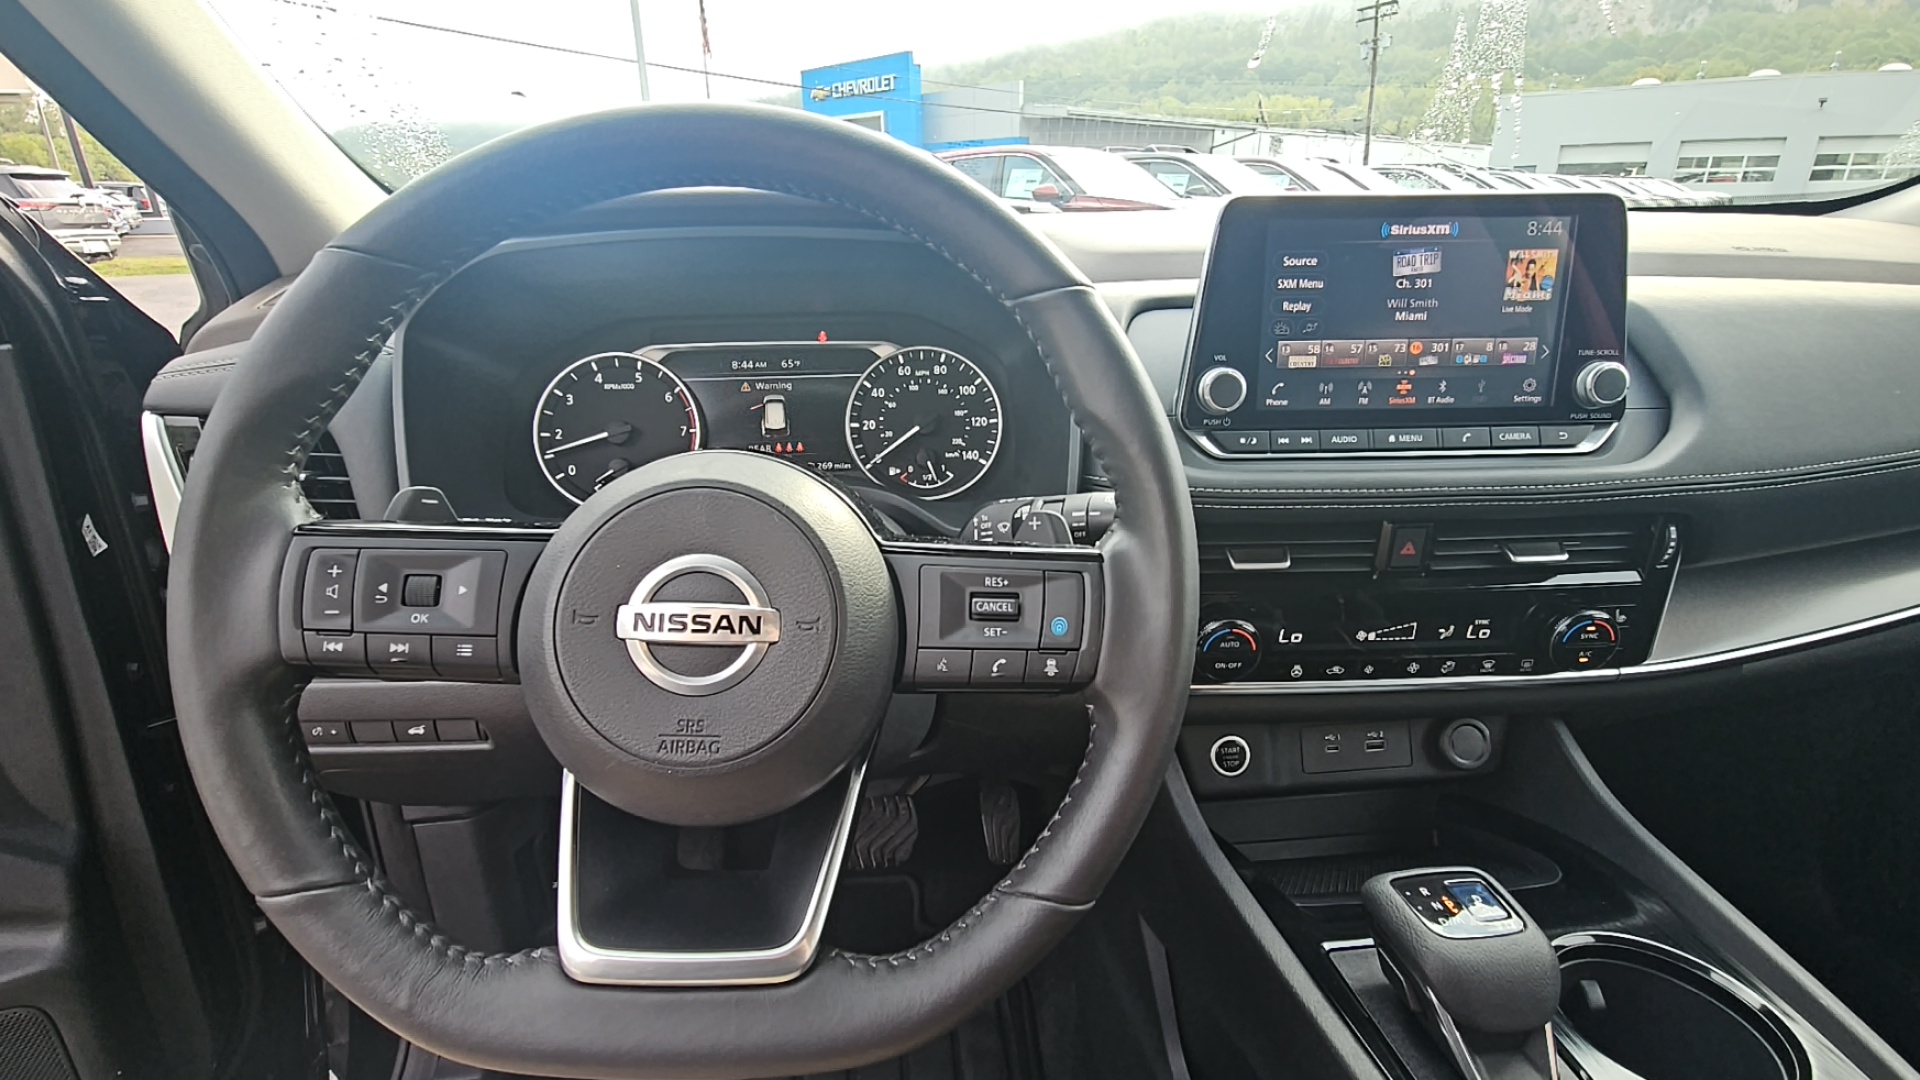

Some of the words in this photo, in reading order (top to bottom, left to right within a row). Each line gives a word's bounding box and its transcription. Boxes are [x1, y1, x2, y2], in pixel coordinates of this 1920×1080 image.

[832, 74, 896, 98] CHEVROLET
[1526, 221, 1563, 236] 8:44
[1283, 256, 1318, 266] Source
[1419, 252, 1439, 266] TRIP
[1277, 279, 1297, 289] SXM
[1299, 279, 1324, 289] Menu
[1396, 278, 1412, 288] Ch.
[1414, 278, 1433, 288] 301
[1282, 301, 1312, 313] Replay
[1387, 298, 1408, 308] Will
[1410, 298, 1438, 308] Smith
[1515, 305, 1533, 313] Mode
[1394, 311, 1427, 321] Miami
[1281, 346, 1290, 354] 13
[1308, 345, 1320, 354] 58
[1325, 345, 1334, 354] 14
[1351, 344, 1363, 354] 57
[1368, 345, 1377, 353] 15
[1394, 344, 1406, 353] 73
[1431, 343, 1449, 352] 301
[1455, 343, 1464, 351] 17
[1486, 342, 1493, 352] 8
[1498, 343, 1507, 351] 18
[1523, 342, 1536, 352] 28
[732, 361, 753, 369] 8:44
[934, 365, 947, 375] 80
[898, 366, 911, 376] 60
[594, 373, 603, 384] 4
[635, 373, 643, 383] 5
[755, 382, 793, 391] Warning
[959, 385, 976, 396] 100
[664, 392, 673, 402] 6
[871, 387, 885, 398] 40
[566, 395, 574, 405] 3
[1266, 398, 1288, 406] Phone
[1359, 397, 1368, 405] FM
[1436, 396, 1455, 404] Audio
[1513, 395, 1542, 404] Settings
[862, 420, 876, 430] 20
[971, 417, 988, 427] 120
[554, 429, 563, 440] 2
[680, 426, 687, 437] 7
[1499, 432, 1531, 441] CAMERA
[1331, 435, 1358, 443] AUDIO
[1399, 434, 1423, 442] MENU
[962, 450, 979, 460] 140
[568, 465, 576, 475] 0
[980, 522, 992, 530] OFF
[984, 576, 1009, 587] RES+
[976, 602, 1013, 612] CANCEL
[410, 613, 429, 623] OK
[632, 612, 763, 635] NISSAN
[983, 627, 1008, 637] SET-
[675, 718, 706, 734] SRS
[657, 739, 721, 755] AIRBAG
[1221, 746, 1240, 754] START
[1419, 887, 1431, 897] R
[1431, 902, 1444, 911] N
